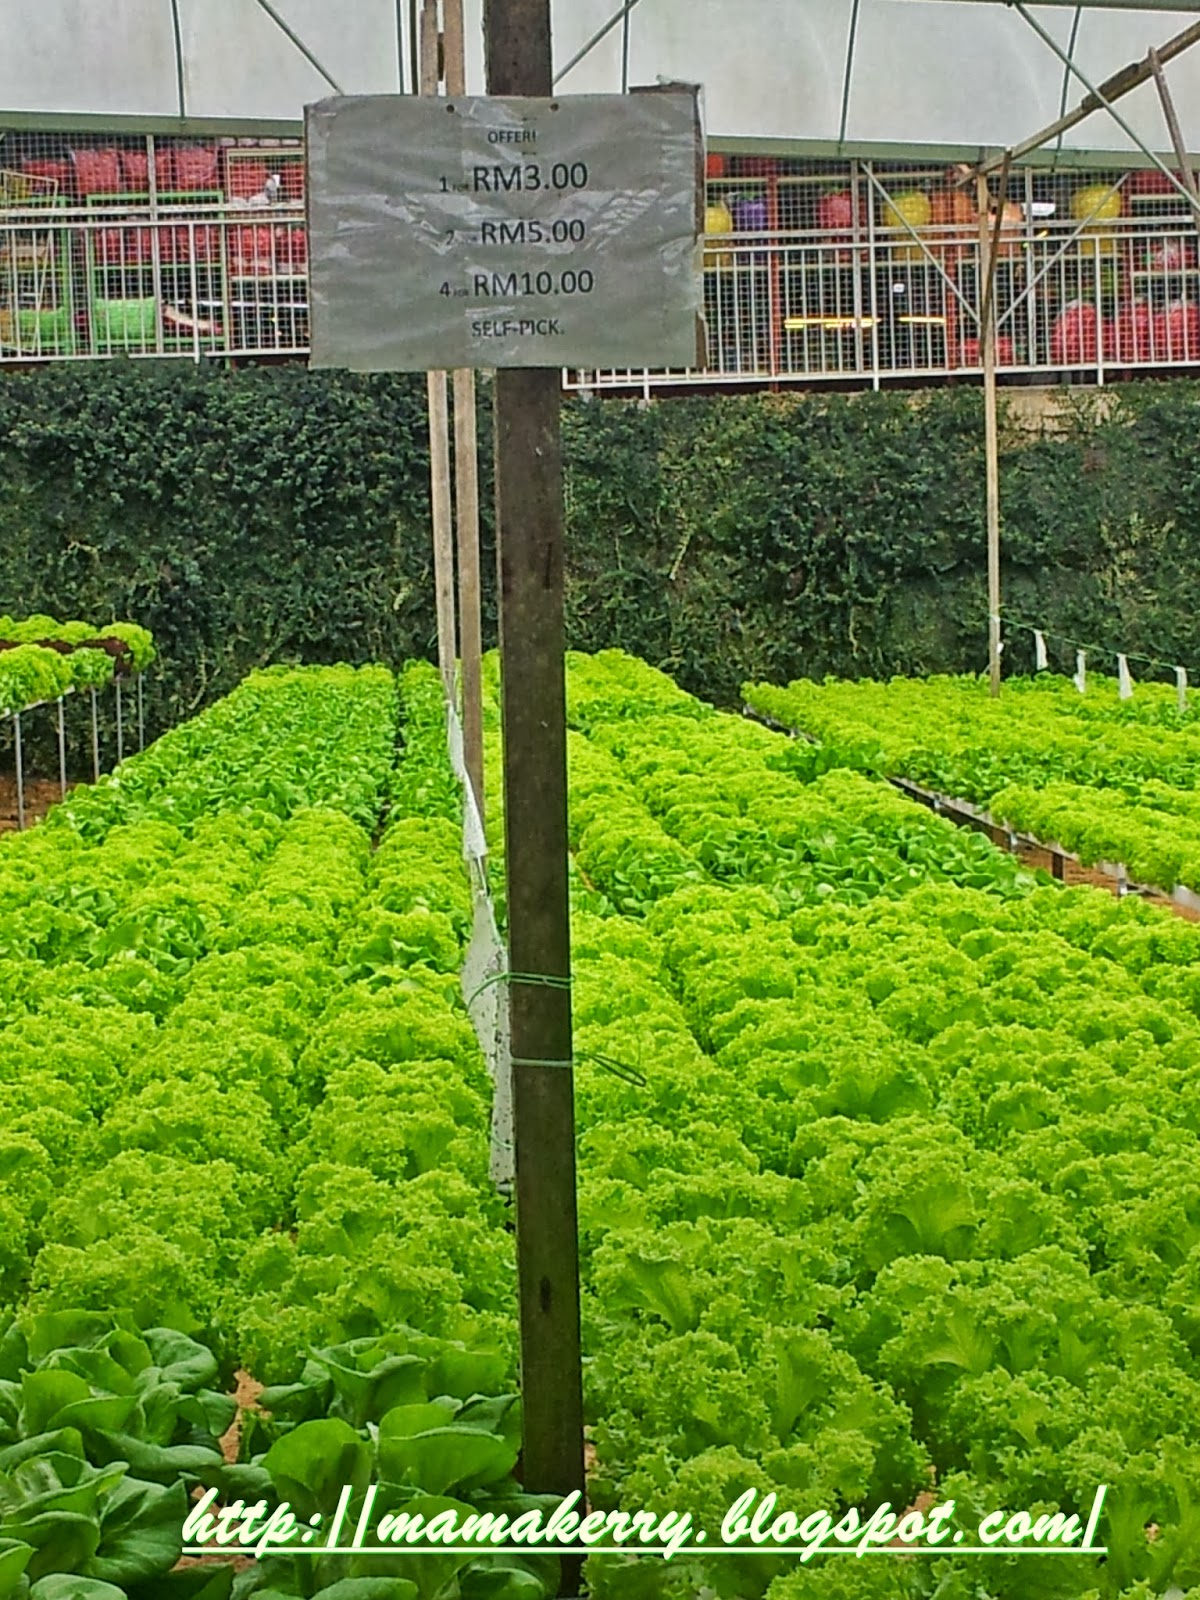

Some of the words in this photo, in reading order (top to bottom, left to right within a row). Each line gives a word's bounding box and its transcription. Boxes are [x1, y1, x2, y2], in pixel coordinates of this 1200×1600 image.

[487, 130, 537, 144] OFFER!
[438, 176, 449, 193] 1
[473, 162, 588, 192] RM3.00
[481, 219, 586, 245] RM5.00
[439, 281, 450, 297] 4
[474, 270, 594, 297] RM10.00
[471, 319, 565, 337] SELF-PICK.
